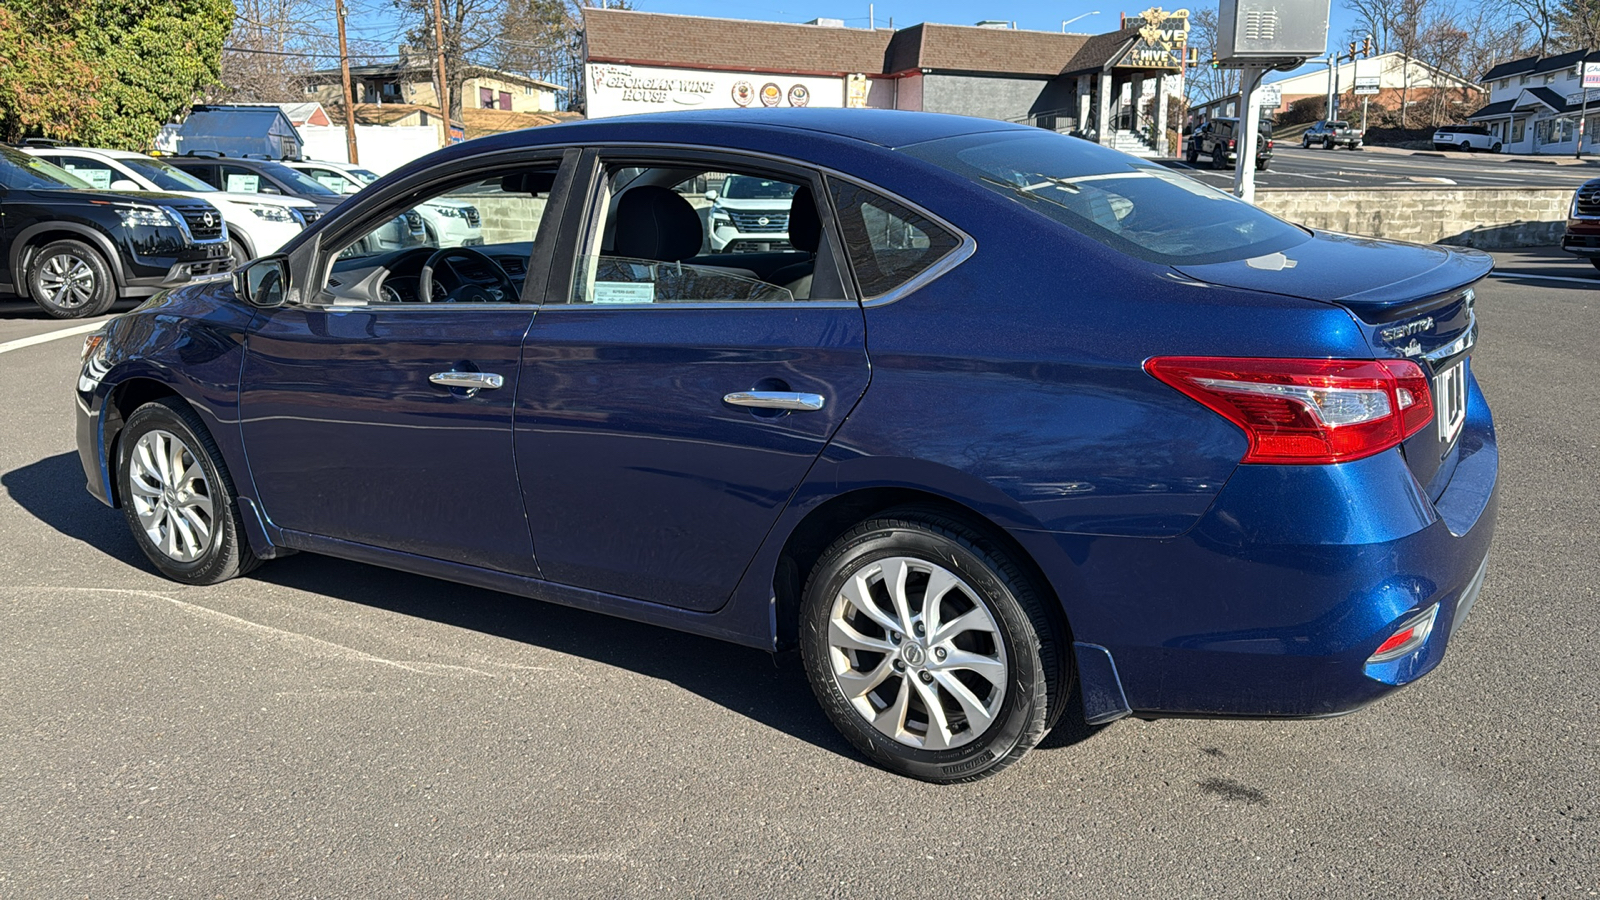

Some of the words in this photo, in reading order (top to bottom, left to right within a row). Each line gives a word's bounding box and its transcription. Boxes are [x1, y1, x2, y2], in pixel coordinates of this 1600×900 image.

[1161, 29, 1185, 41] VE
[1140, 49, 1168, 61] HIVE
[606, 76, 674, 91] GEORGIAN
[679, 80, 715, 94] WINE
[621, 90, 667, 103] HOUSE
[1380, 316, 1434, 342] SENTRA
